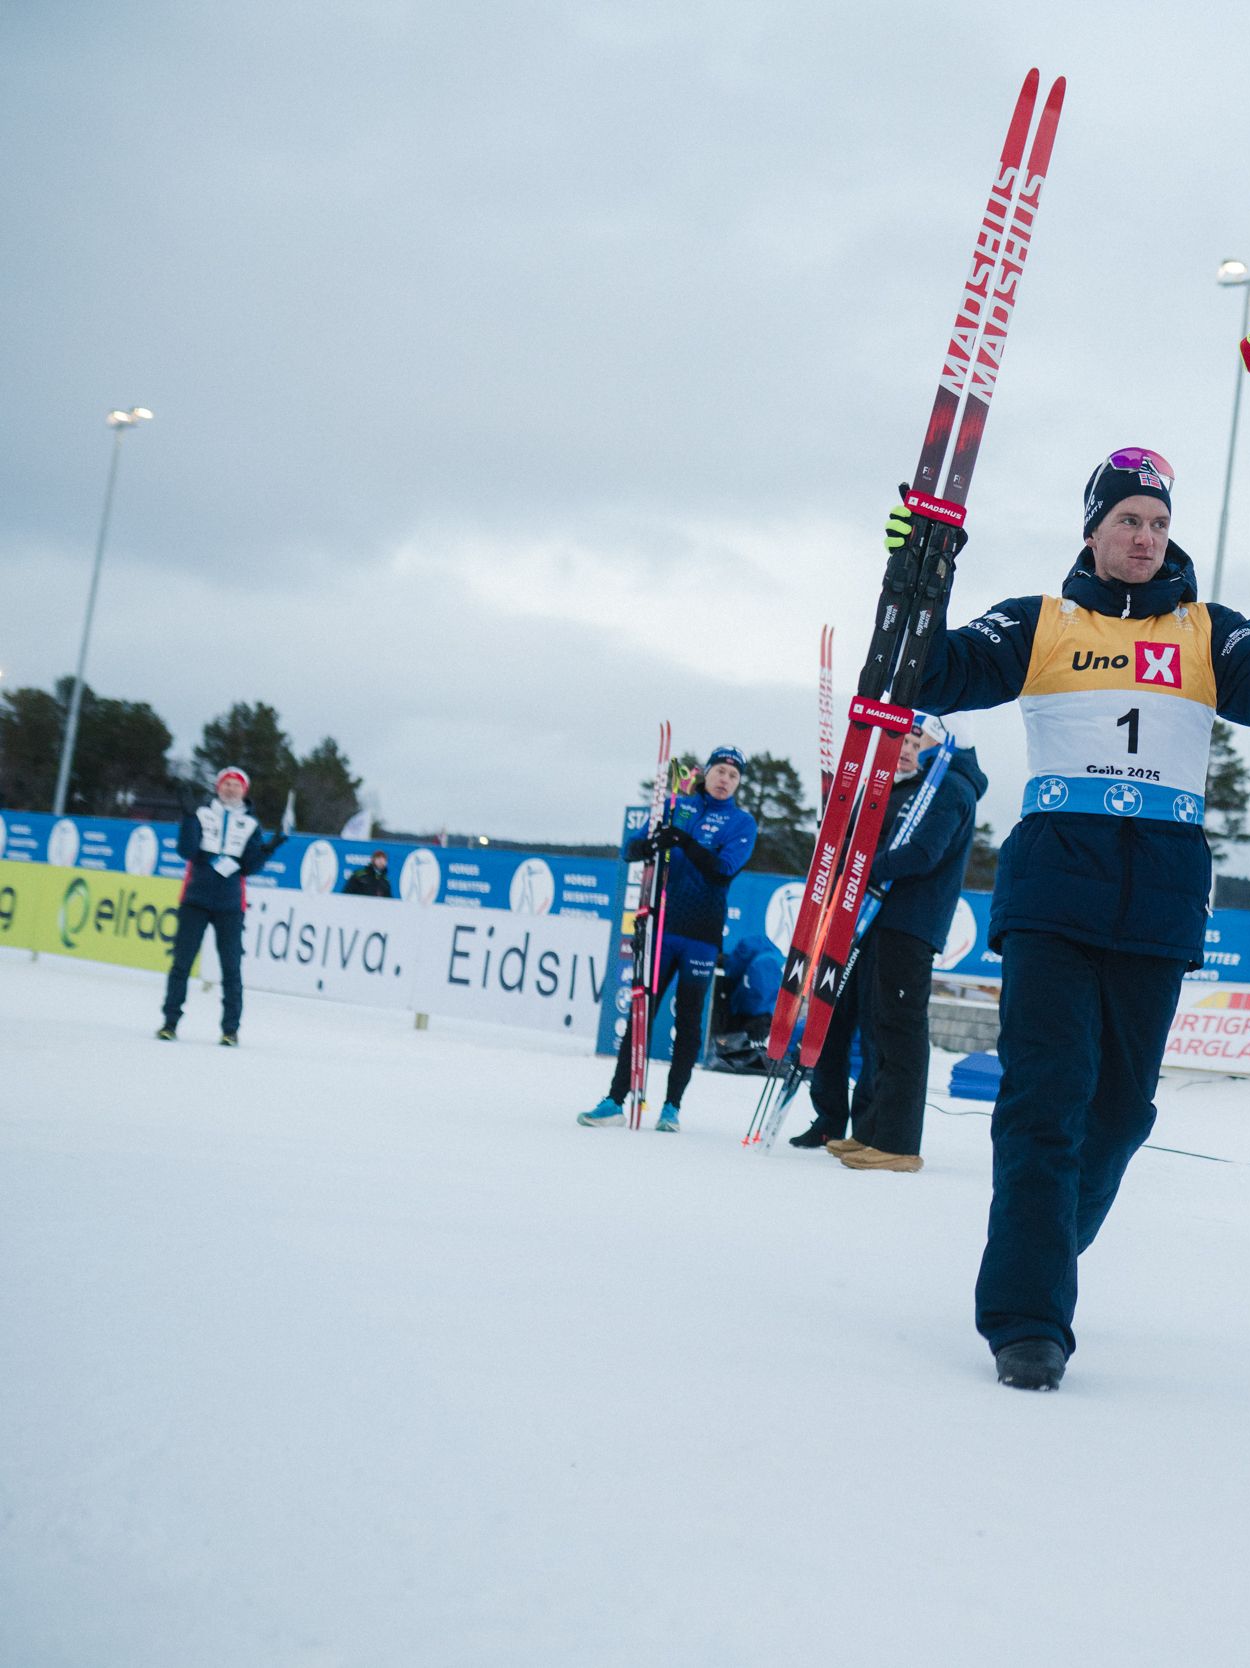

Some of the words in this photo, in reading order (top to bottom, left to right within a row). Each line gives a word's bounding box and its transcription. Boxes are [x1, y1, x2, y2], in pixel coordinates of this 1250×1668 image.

[939, 161, 1019, 398] MADSHUS
[969, 169, 1046, 406] MADSHUS
[920, 501, 963, 520] MADSHUS
[1071, 650, 1129, 671] Uno
[1142, 646, 1176, 684] X
[865, 708, 910, 725] MADSHUS
[1117, 708, 1140, 755] 1
[843, 761, 860, 773] 192
[875, 769, 891, 781] 192
[1127, 766, 1161, 782] 2025
[810, 842, 836, 905] REDLINE
[841, 850, 867, 913] REDLINE
[246, 902, 402, 990] idsiva.
